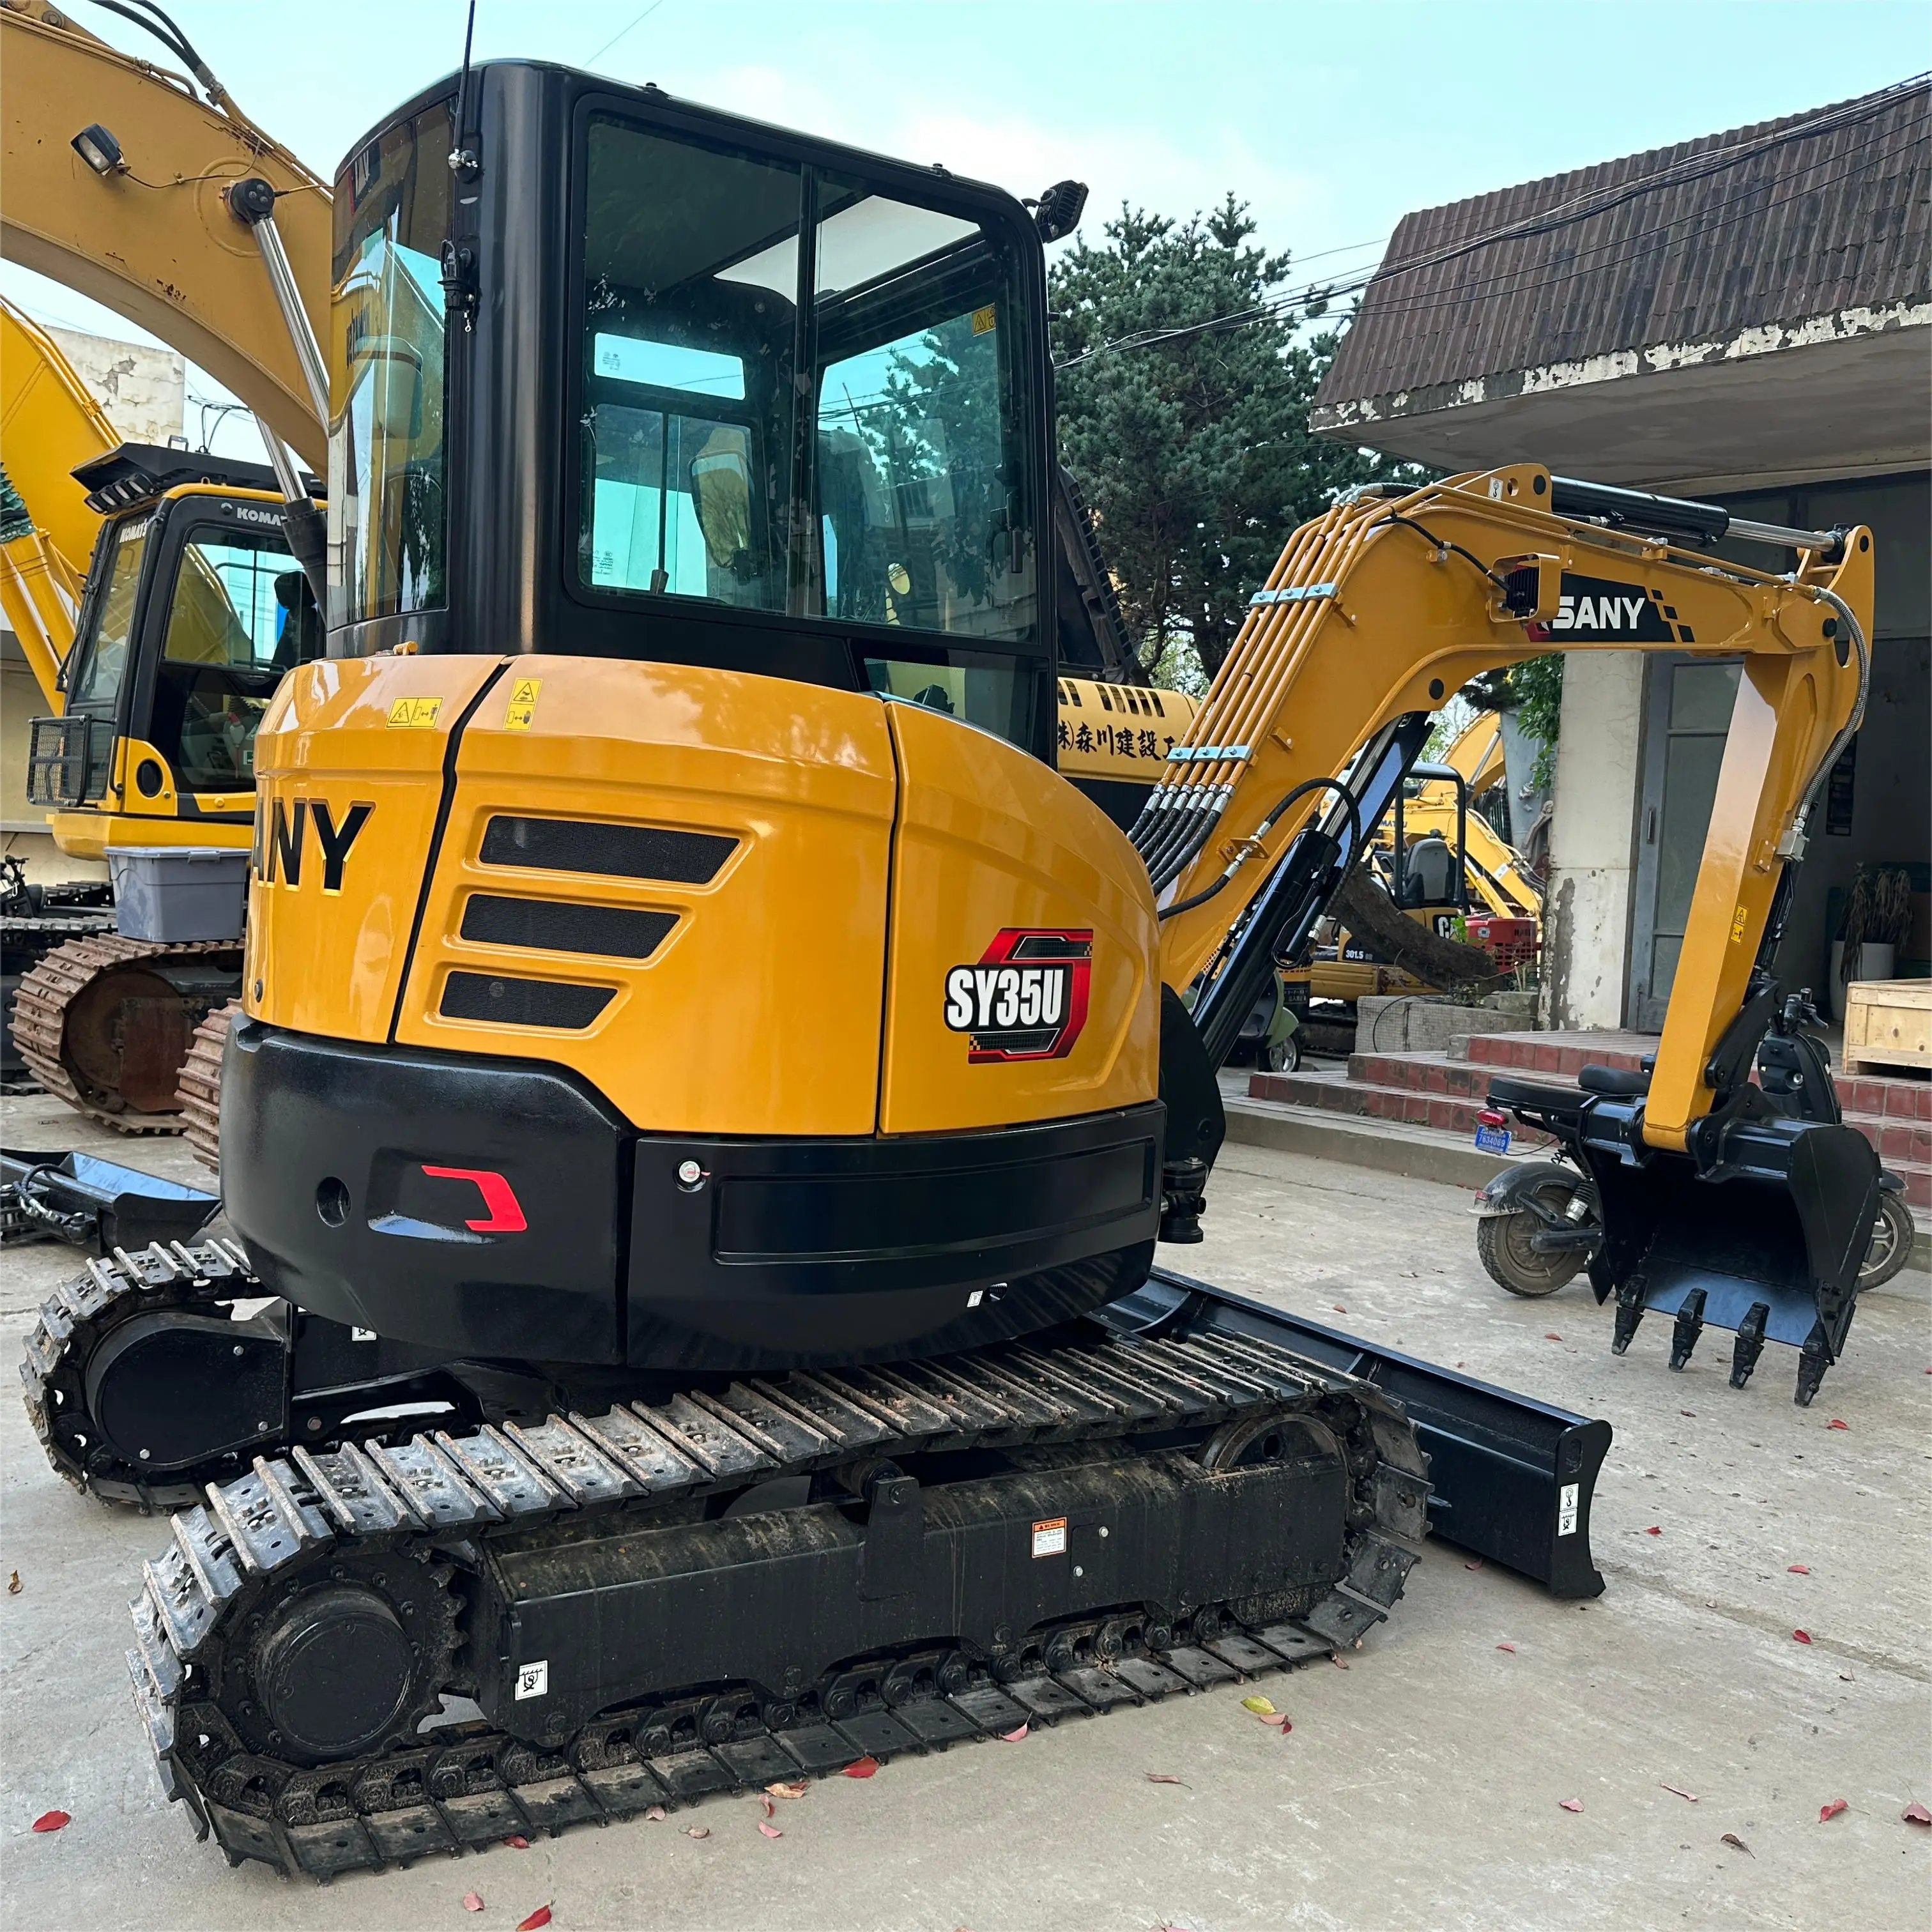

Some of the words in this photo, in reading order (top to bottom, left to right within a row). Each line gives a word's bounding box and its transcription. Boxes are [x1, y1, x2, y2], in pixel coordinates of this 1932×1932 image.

[119, 522, 148, 543] KOMATS
[1552, 596, 1645, 629] SANY
[1346, 949, 1364, 960] 301.5
[947, 969, 1064, 1027] SY35U
